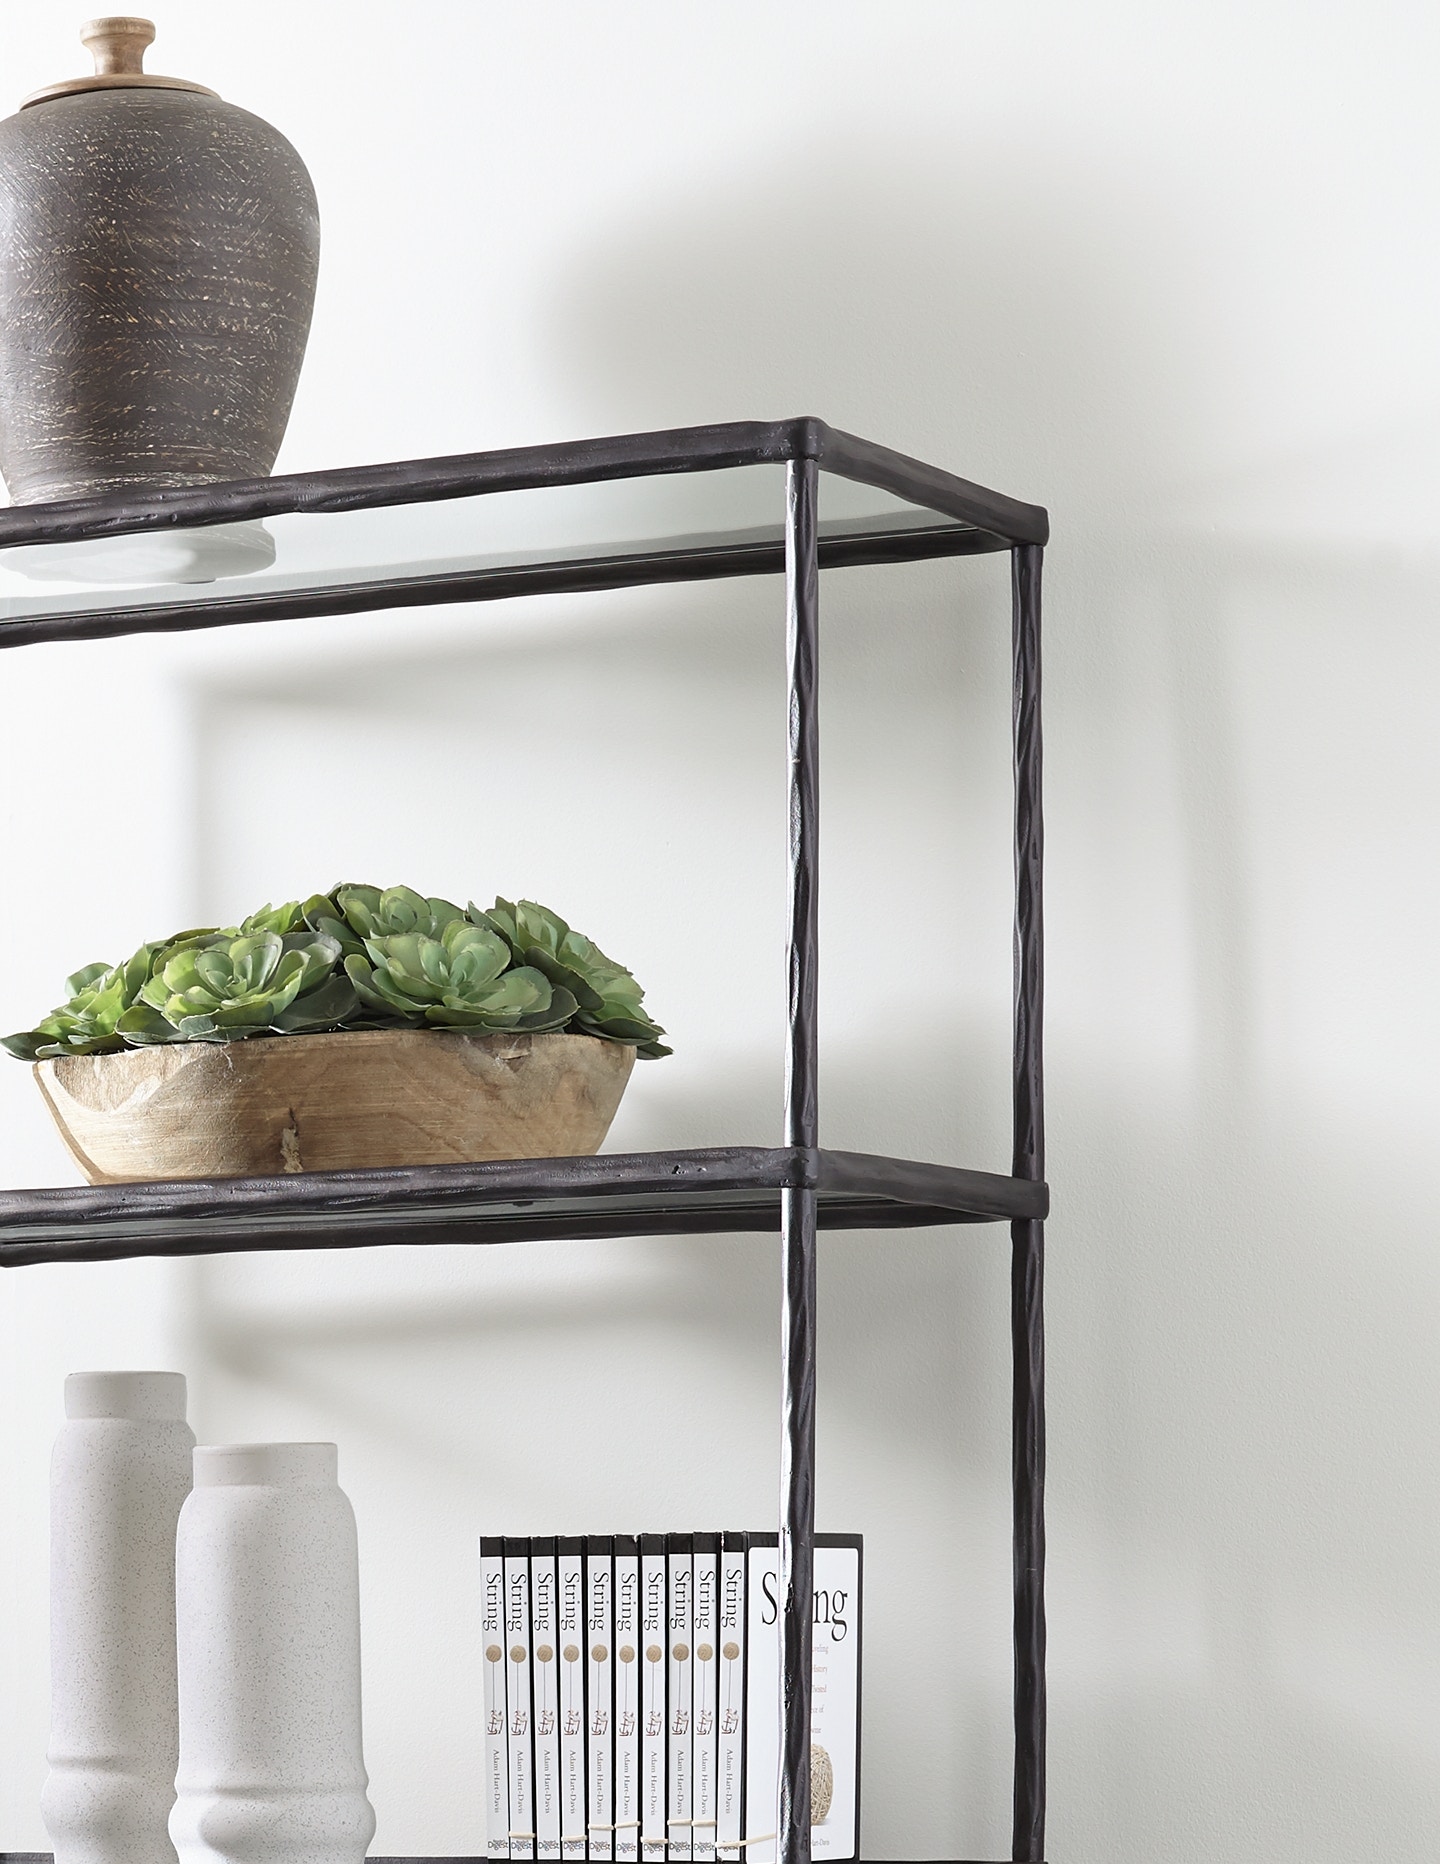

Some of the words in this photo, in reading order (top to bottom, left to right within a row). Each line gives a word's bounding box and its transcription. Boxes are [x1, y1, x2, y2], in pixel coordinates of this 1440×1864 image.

[482, 1572, 503, 1632] String
[506, 1573, 527, 1632] String
[534, 1572, 554, 1632] String
[560, 1572, 581, 1632] String
[589, 1572, 610, 1632] String
[616, 1572, 637, 1632] String
[643, 1572, 664, 1632] String
[670, 1570, 691, 1630] String
[695, 1570, 716, 1630] String
[721, 1569, 743, 1629] String
[761, 1571, 849, 1642] Sng
